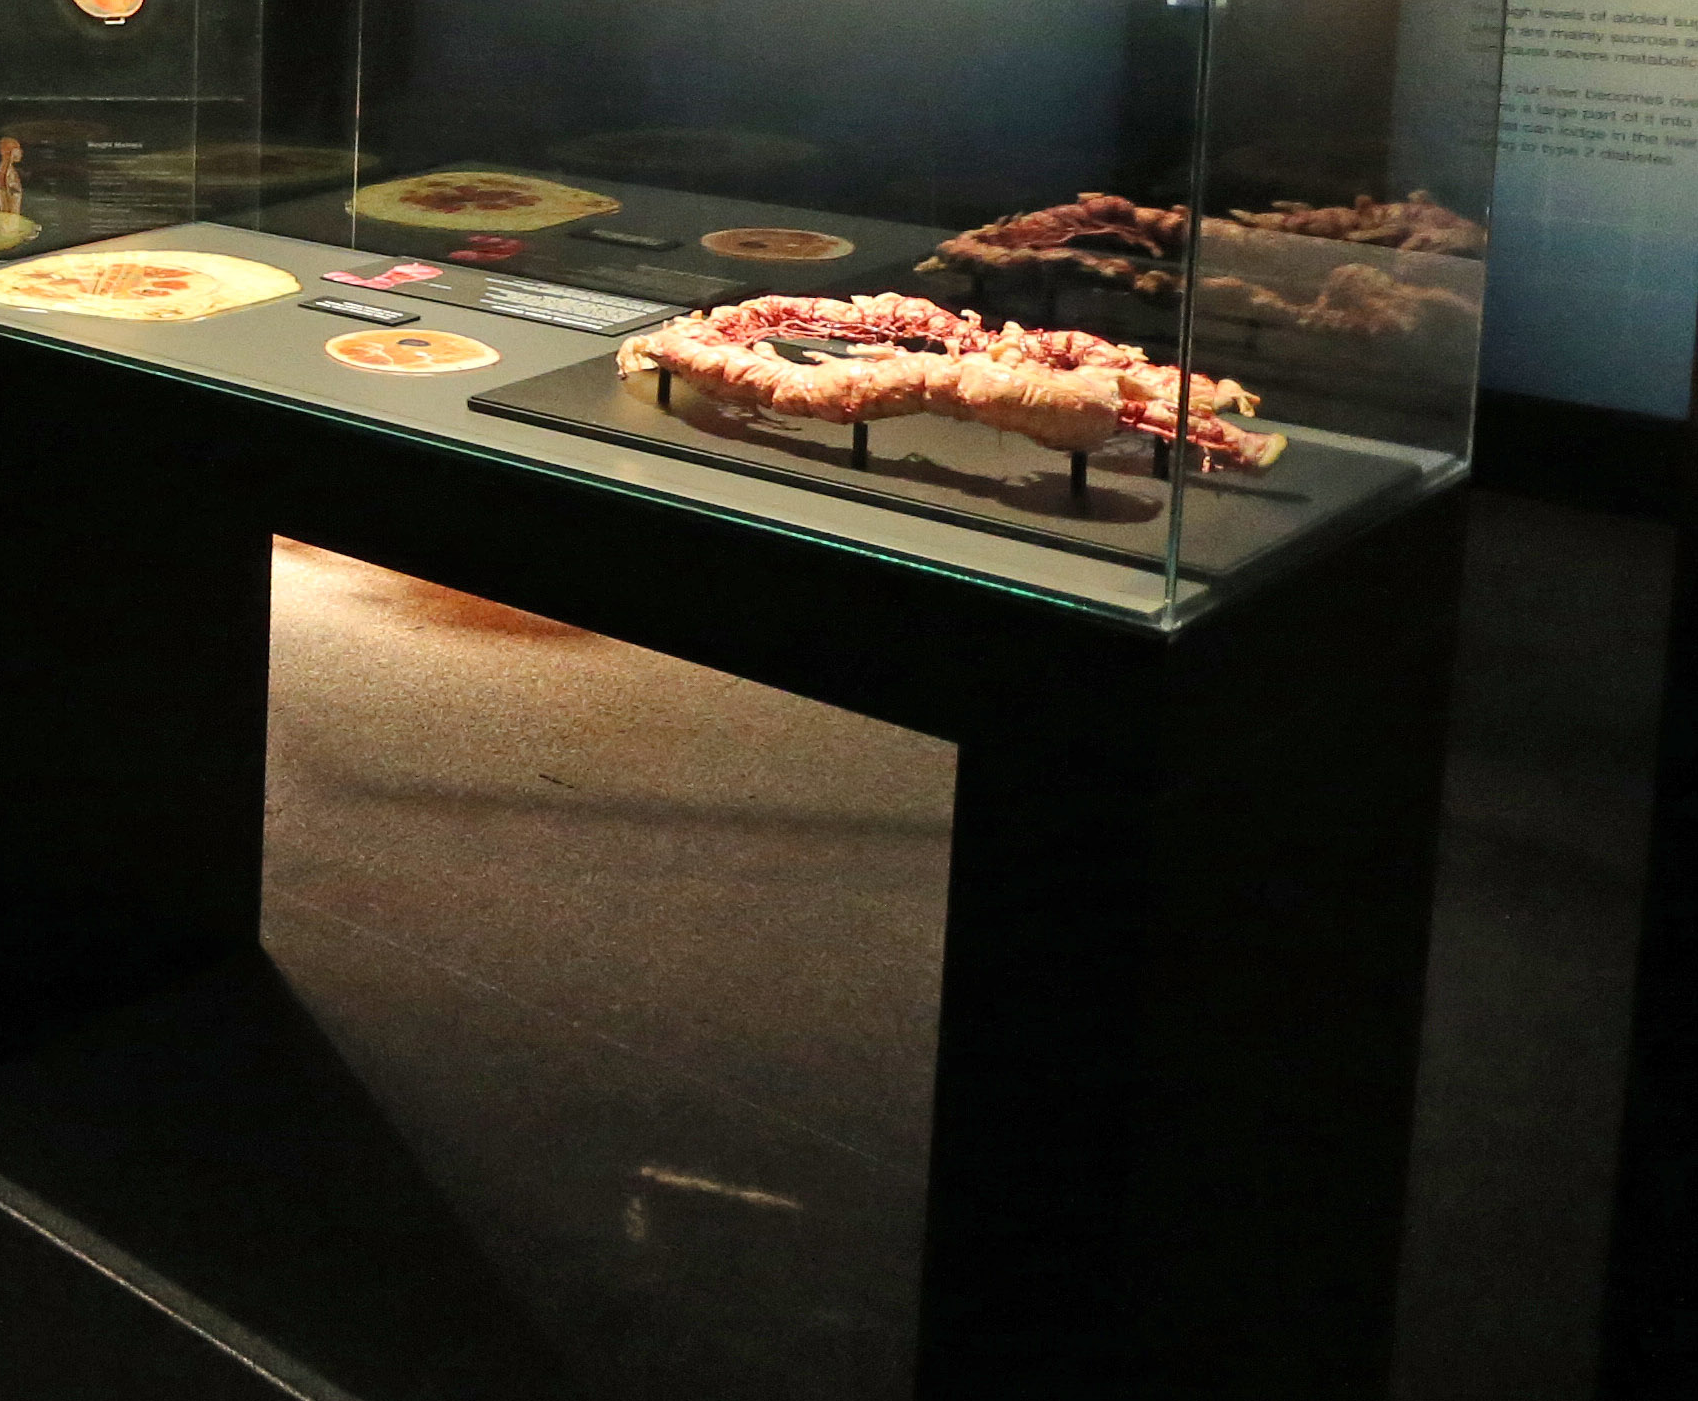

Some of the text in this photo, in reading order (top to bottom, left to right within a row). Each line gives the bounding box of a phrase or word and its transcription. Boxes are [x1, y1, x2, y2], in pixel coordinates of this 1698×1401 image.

[1613, 12, 1667, 26] added
[1610, 33, 1679, 48] sucrose
[1586, 88, 1664, 104] becomes
[1583, 109, 1617, 121] part
[1631, 131, 1658, 144] the
